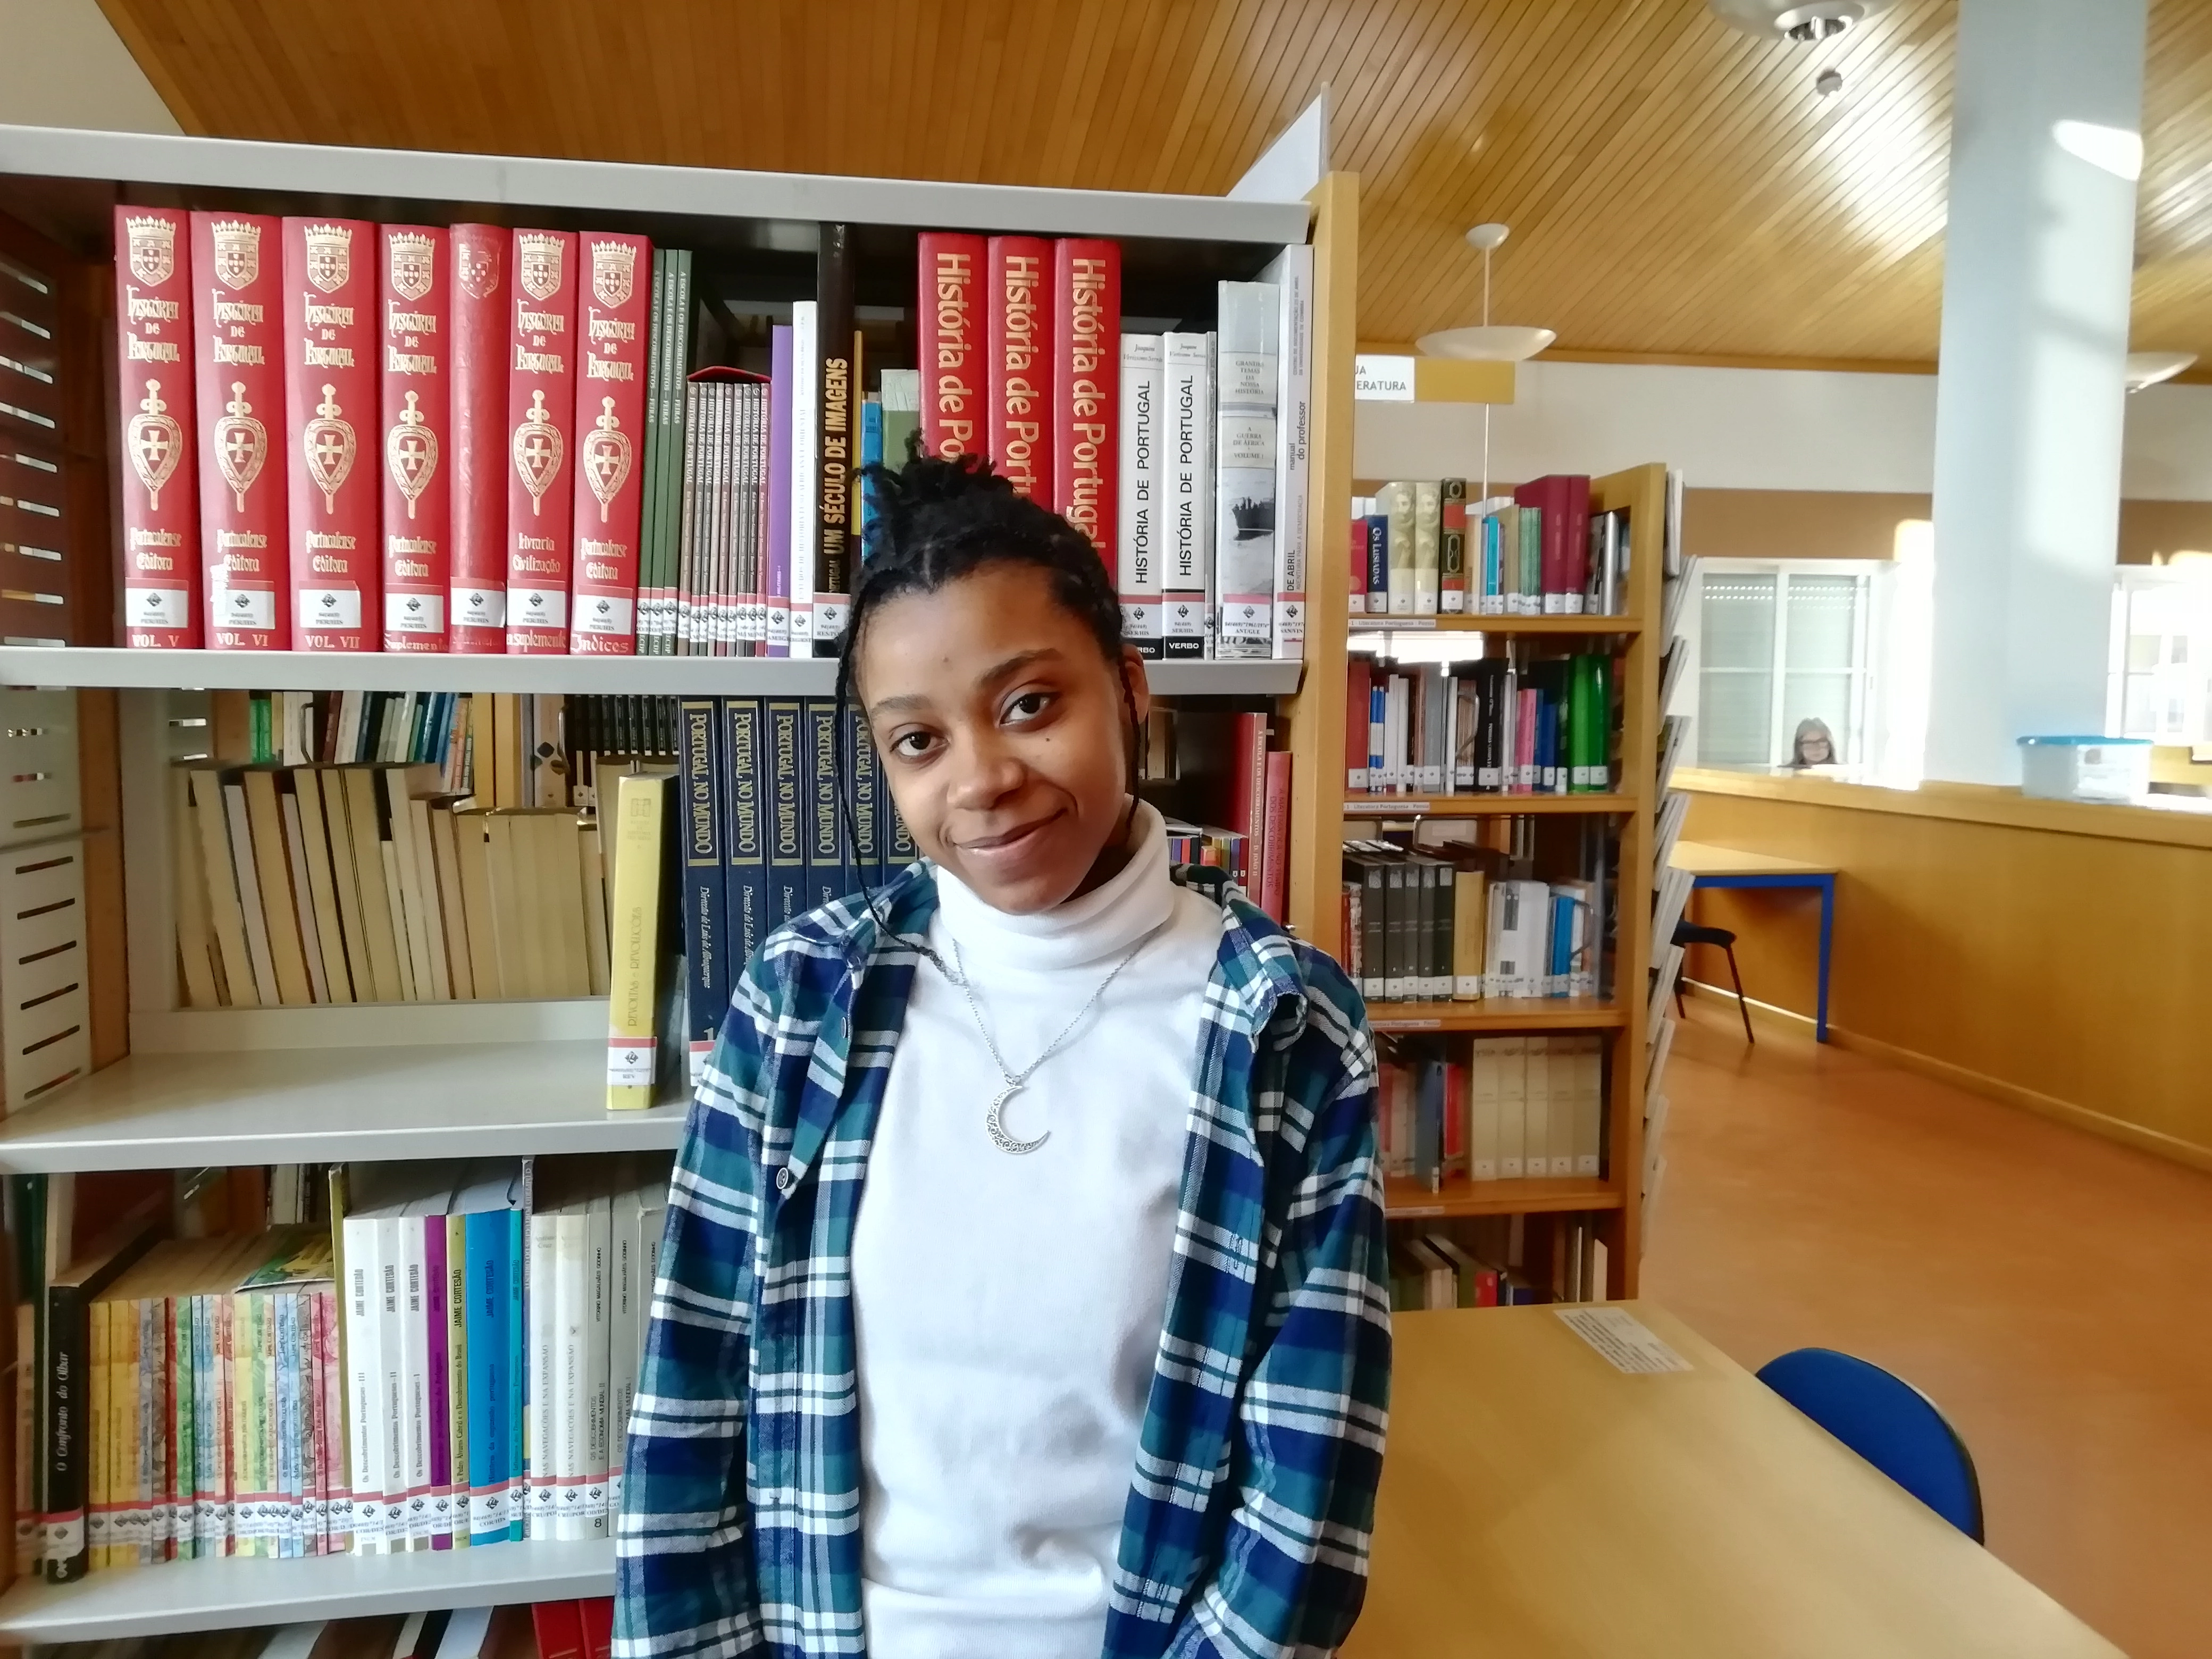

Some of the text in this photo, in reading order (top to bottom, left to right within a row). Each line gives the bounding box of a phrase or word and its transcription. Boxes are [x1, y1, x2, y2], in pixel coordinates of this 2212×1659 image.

[937, 253, 971, 368] História
[1006, 256, 1039, 371] História
[1073, 259, 1105, 373] História
[675, 324, 684, 390] DESCOBRIMENTOS
[825, 358, 848, 431] IMAGENS
[939, 375, 972, 413] de
[1006, 377, 1039, 415] de
[1073, 379, 1105, 417] de
[824, 435, 847, 458] DE
[1298, 448, 1305, 460] do
[819, 463, 847, 524] SÉCULO
[1133, 381, 1150, 583] HISTÓRIA DE PORTUGAL
[1177, 375, 1193, 576] HISTÓRIA DE PORTUGAL
[137, 553, 173, 571] Editora
[224, 554, 259, 572] Editora
[313, 556, 348, 573] Editora
[512, 555, 560, 574] Civilização
[518, 532, 555, 551] Livraria
[824, 529, 845, 555] UM
[586, 562, 618, 580] Editora
[1287, 579, 1295, 591] DE
[132, 634, 179, 648] VOL. V
[216, 632, 269, 647] VOL. VI
[305, 635, 360, 649] VOL. VII
[690, 713, 712, 853] PORTUGAL NO MUNDO
[734, 713, 756, 852] PORTUGAL NO MUNDO
[776, 715, 796, 853] PORTUGAL NO MUNDO
[816, 716, 835, 853] PORTUGAL NO MUNDO
[857, 782, 872, 801] NO
[1256, 768, 1262, 776] OS
[856, 802, 873, 853] MUNDO
[1253, 778, 1262, 836] DESCOBRIMENTOS
[1266, 816, 1277, 887] DESCOBRIMENTOS
[629, 906, 642, 1026] REVOLTAS REVOLUÇÕES
[354, 1269, 364, 1316] JAIME CORTESÃO
[384, 1265, 396, 1312] JAIME CORTESÃO
[408, 1264, 420, 1312] JAIME CORTESÃO
[452, 1270, 462, 1304] CORTESÃO
[56, 1352, 71, 1472] O Confronto do Olhar
[392, 1421, 400, 1468] Descobrimentos
[414, 1420, 423, 1467] Descobrimentos
[590, 1452, 597, 1460] OS
[594, 1518, 601, 1528] 8
